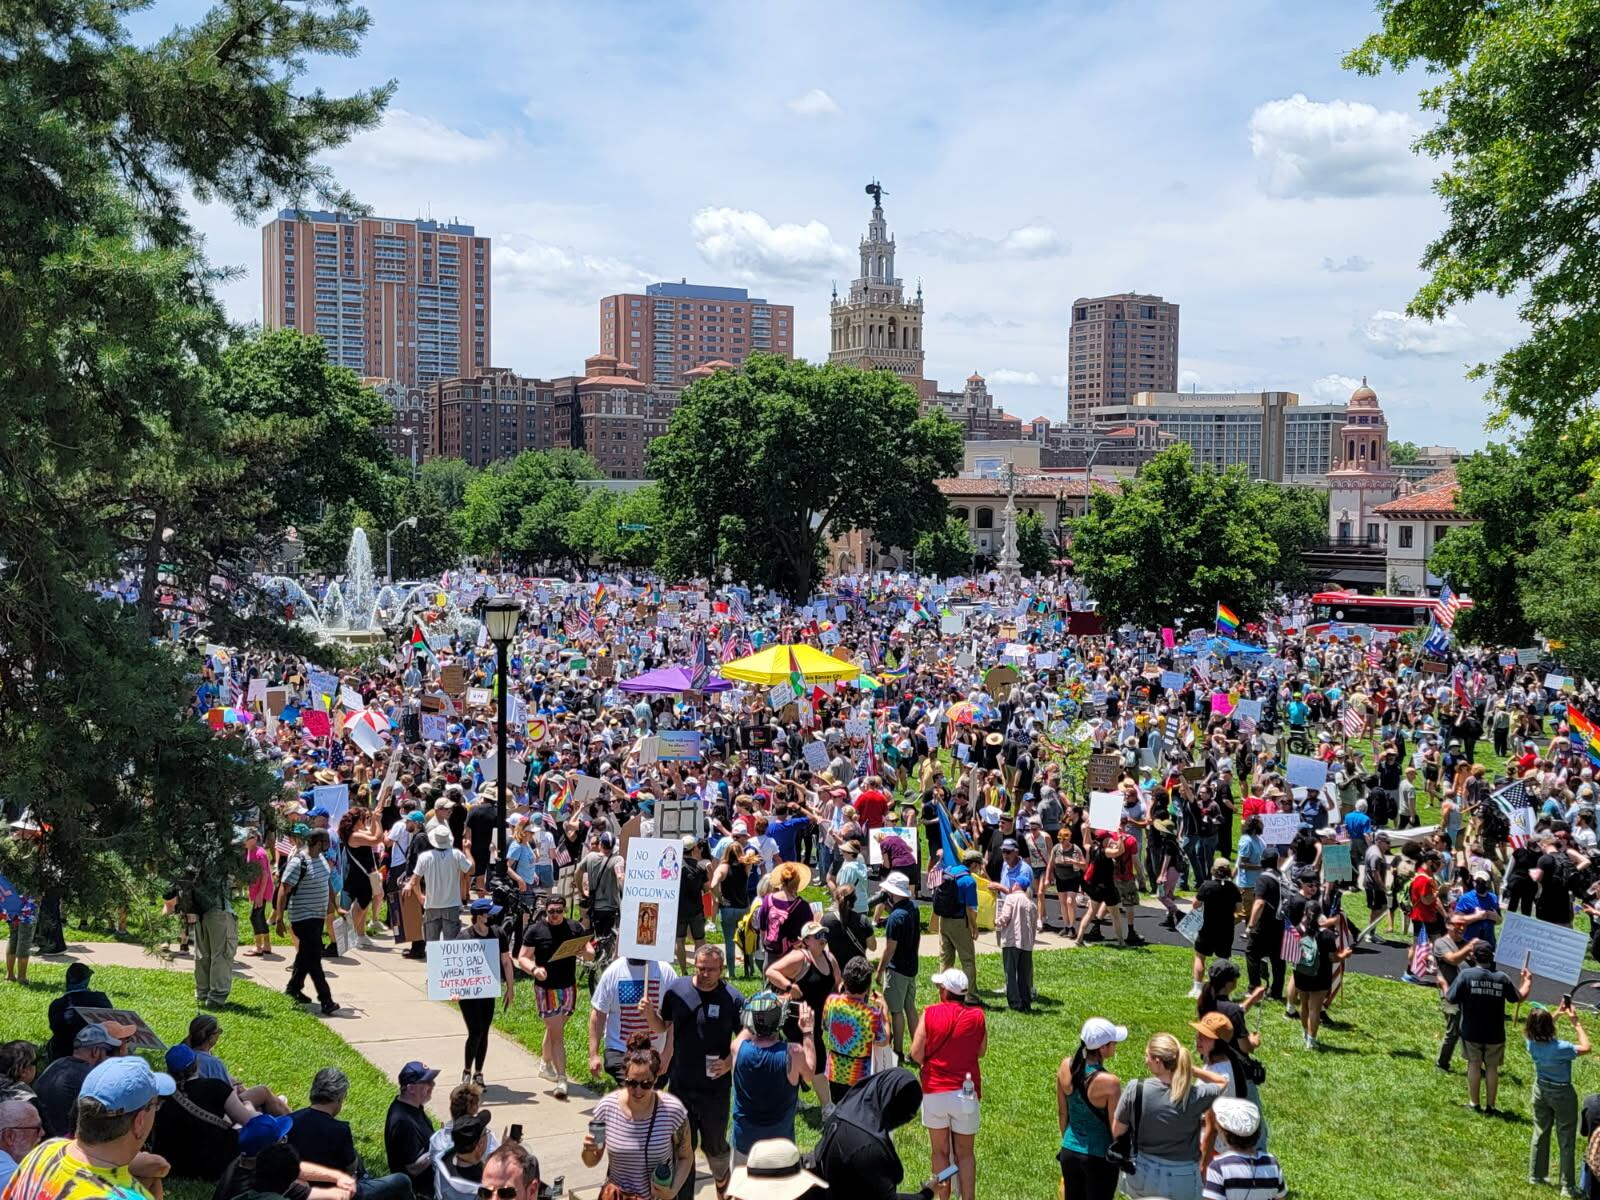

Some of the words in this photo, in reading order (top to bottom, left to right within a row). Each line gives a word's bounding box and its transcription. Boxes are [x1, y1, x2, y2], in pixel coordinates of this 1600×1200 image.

[636, 850, 649, 861] NO
[628, 869, 655, 880] KINGS
[440, 943, 459, 955] YOU
[462, 943, 486, 954] KNOW
[466, 955, 484, 967] BAD
[440, 968, 465, 979] WHEN
[466, 966, 483, 977] THE
[440, 975, 492, 989] INTROVERTS
[449, 987, 471, 997] SHOW
[473, 987, 483, 996] UP
